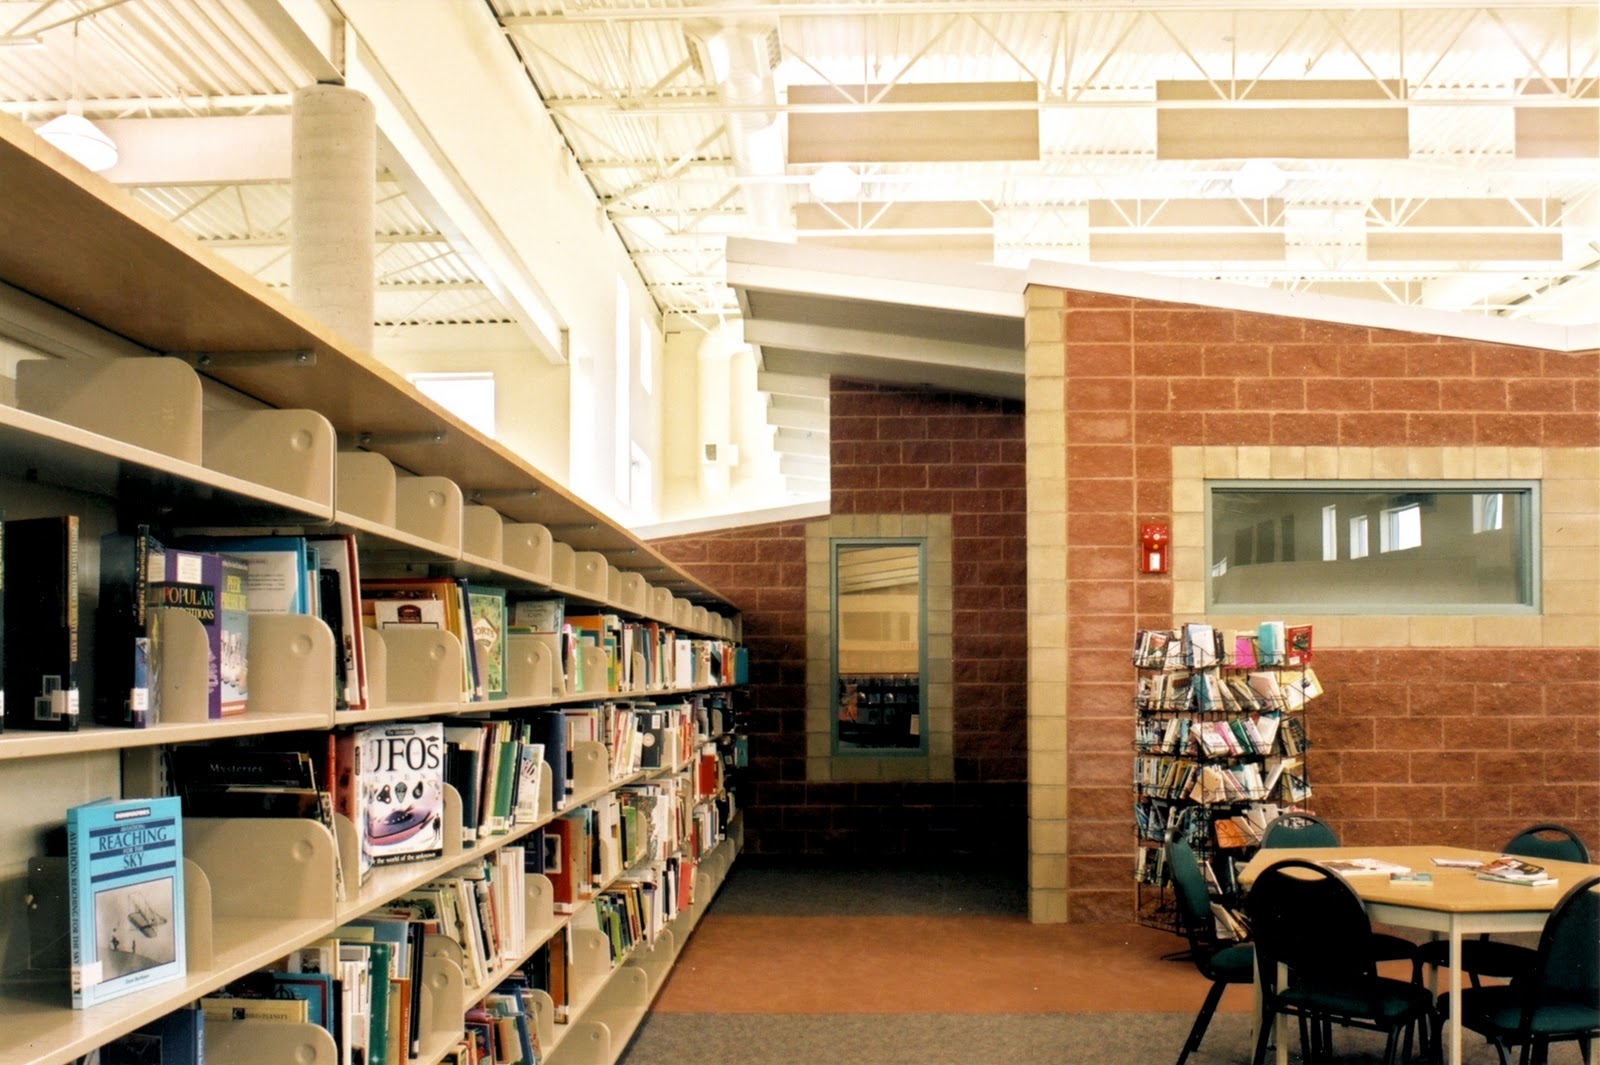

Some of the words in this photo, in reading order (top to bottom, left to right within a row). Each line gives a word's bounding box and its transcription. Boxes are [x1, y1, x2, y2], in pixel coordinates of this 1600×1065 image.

[162, 587, 215, 606] POPULAR
[210, 763, 263, 773] Mysteries
[99, 827, 167, 851] REACHING
[123, 853, 144, 869] SKY
[71, 878, 79, 916] REACHING
